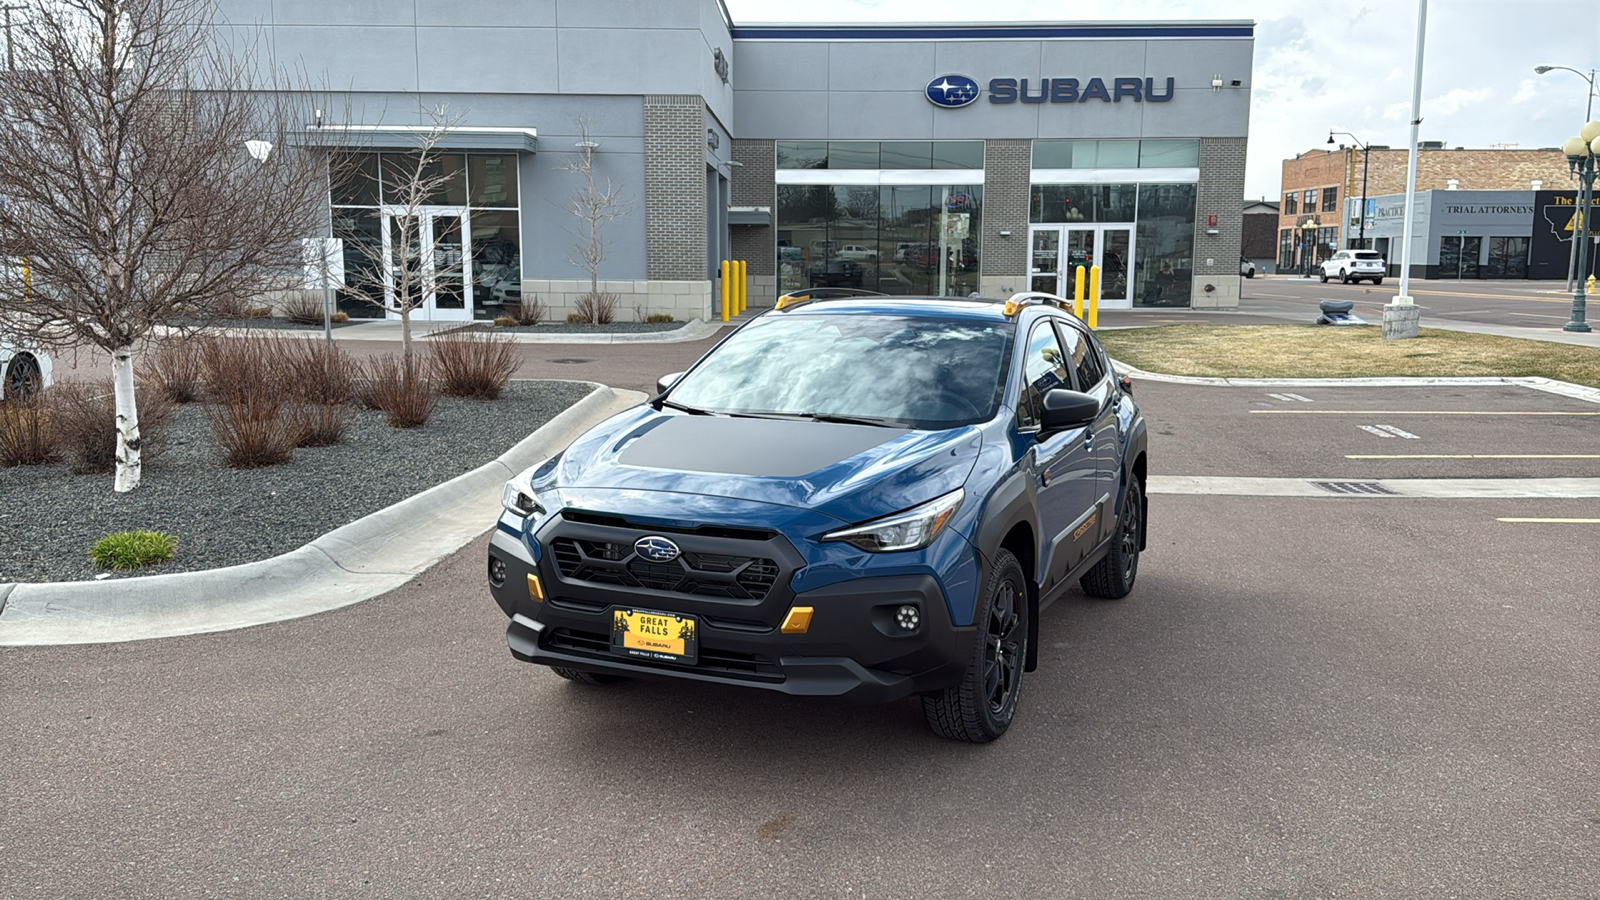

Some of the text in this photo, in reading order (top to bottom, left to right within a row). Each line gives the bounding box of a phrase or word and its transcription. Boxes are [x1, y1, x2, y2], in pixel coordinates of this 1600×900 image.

[988, 77, 1175, 104] SUBARU
[1554, 196, 1573, 205] The
[1378, 206, 1404, 217] PRACTICE
[1447, 206, 1534, 214] TRIAL ATTORNEYS
[640, 616, 668, 627] GREAT
[640, 625, 668, 636] FALLS
